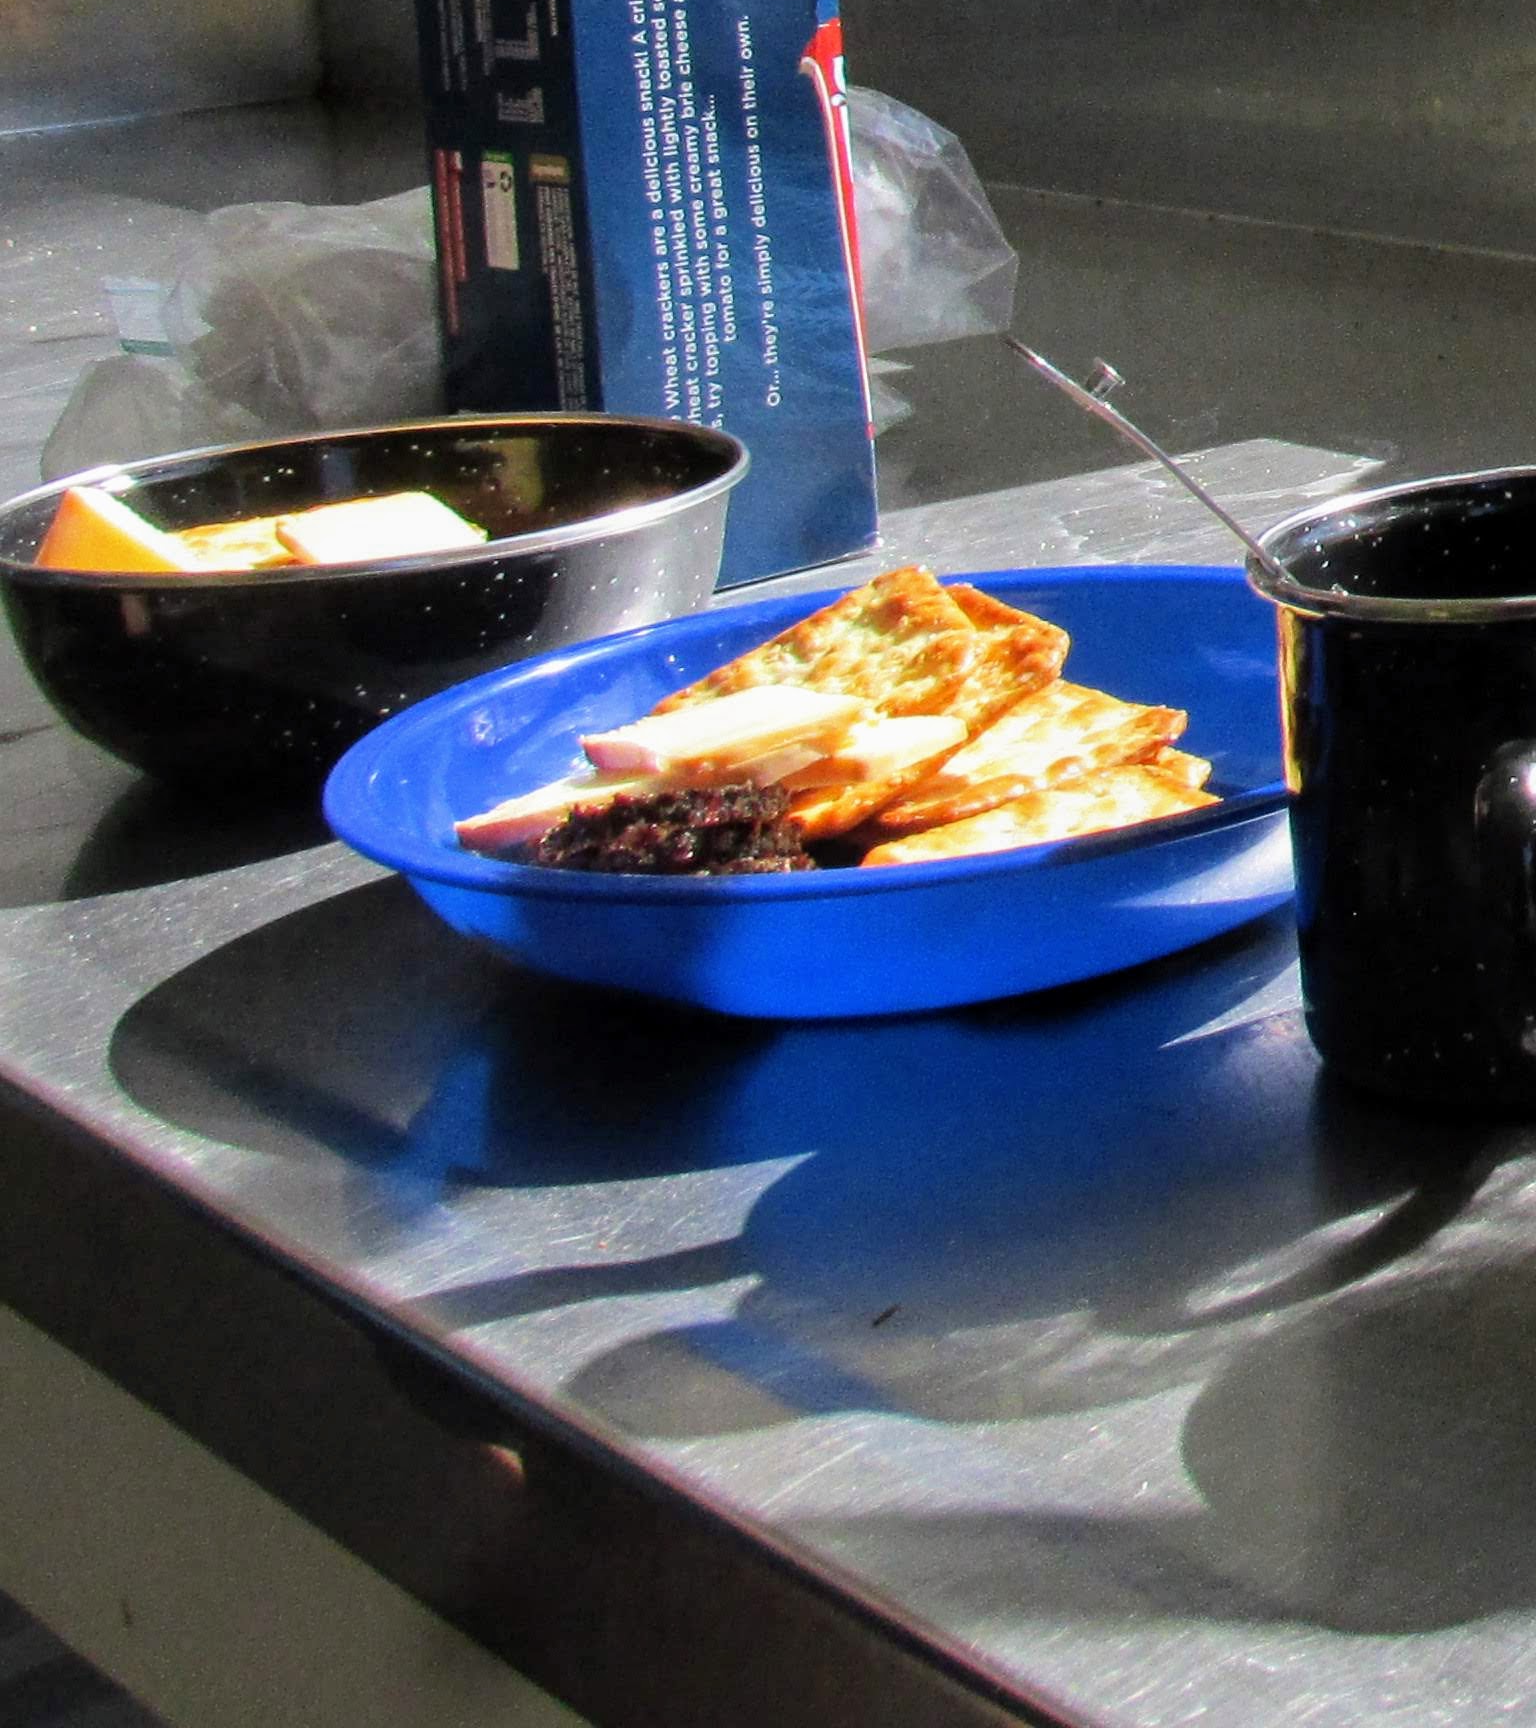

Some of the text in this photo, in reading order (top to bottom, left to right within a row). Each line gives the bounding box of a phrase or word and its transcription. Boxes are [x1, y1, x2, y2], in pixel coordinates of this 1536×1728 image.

[633, 31, 647, 44] A
[652, 18, 672, 90] toasted
[673, 9, 691, 75] cheese
[736, 16, 752, 59] own.
[680, 82, 696, 118] brie
[739, 66, 756, 109] their
[660, 96, 680, 156] lightly
[745, 115, 758, 138] on
[643, 117, 662, 203] delicious
[664, 162, 681, 203] with
[684, 125, 702, 193] creamy
[749, 144, 767, 227] delicious
[651, 209, 663, 219] a
[710, 169, 728, 218] great
[652, 226, 668, 256] are
[690, 200, 708, 249] some
[714, 225, 727, 236] a
[673, 209, 693, 296] sprinkled
[695, 256, 712, 296] with
[715, 242, 729, 268] for
[754, 234, 772, 294] simply
[658, 262, 676, 340] crackers
[718, 275, 737, 343] tomato
[680, 303, 698, 371] cracker
[700, 302, 720, 376] topping
[761, 300, 778, 365] they're
[663, 347, 681, 408] Wheat
[707, 382, 724, 408] try
